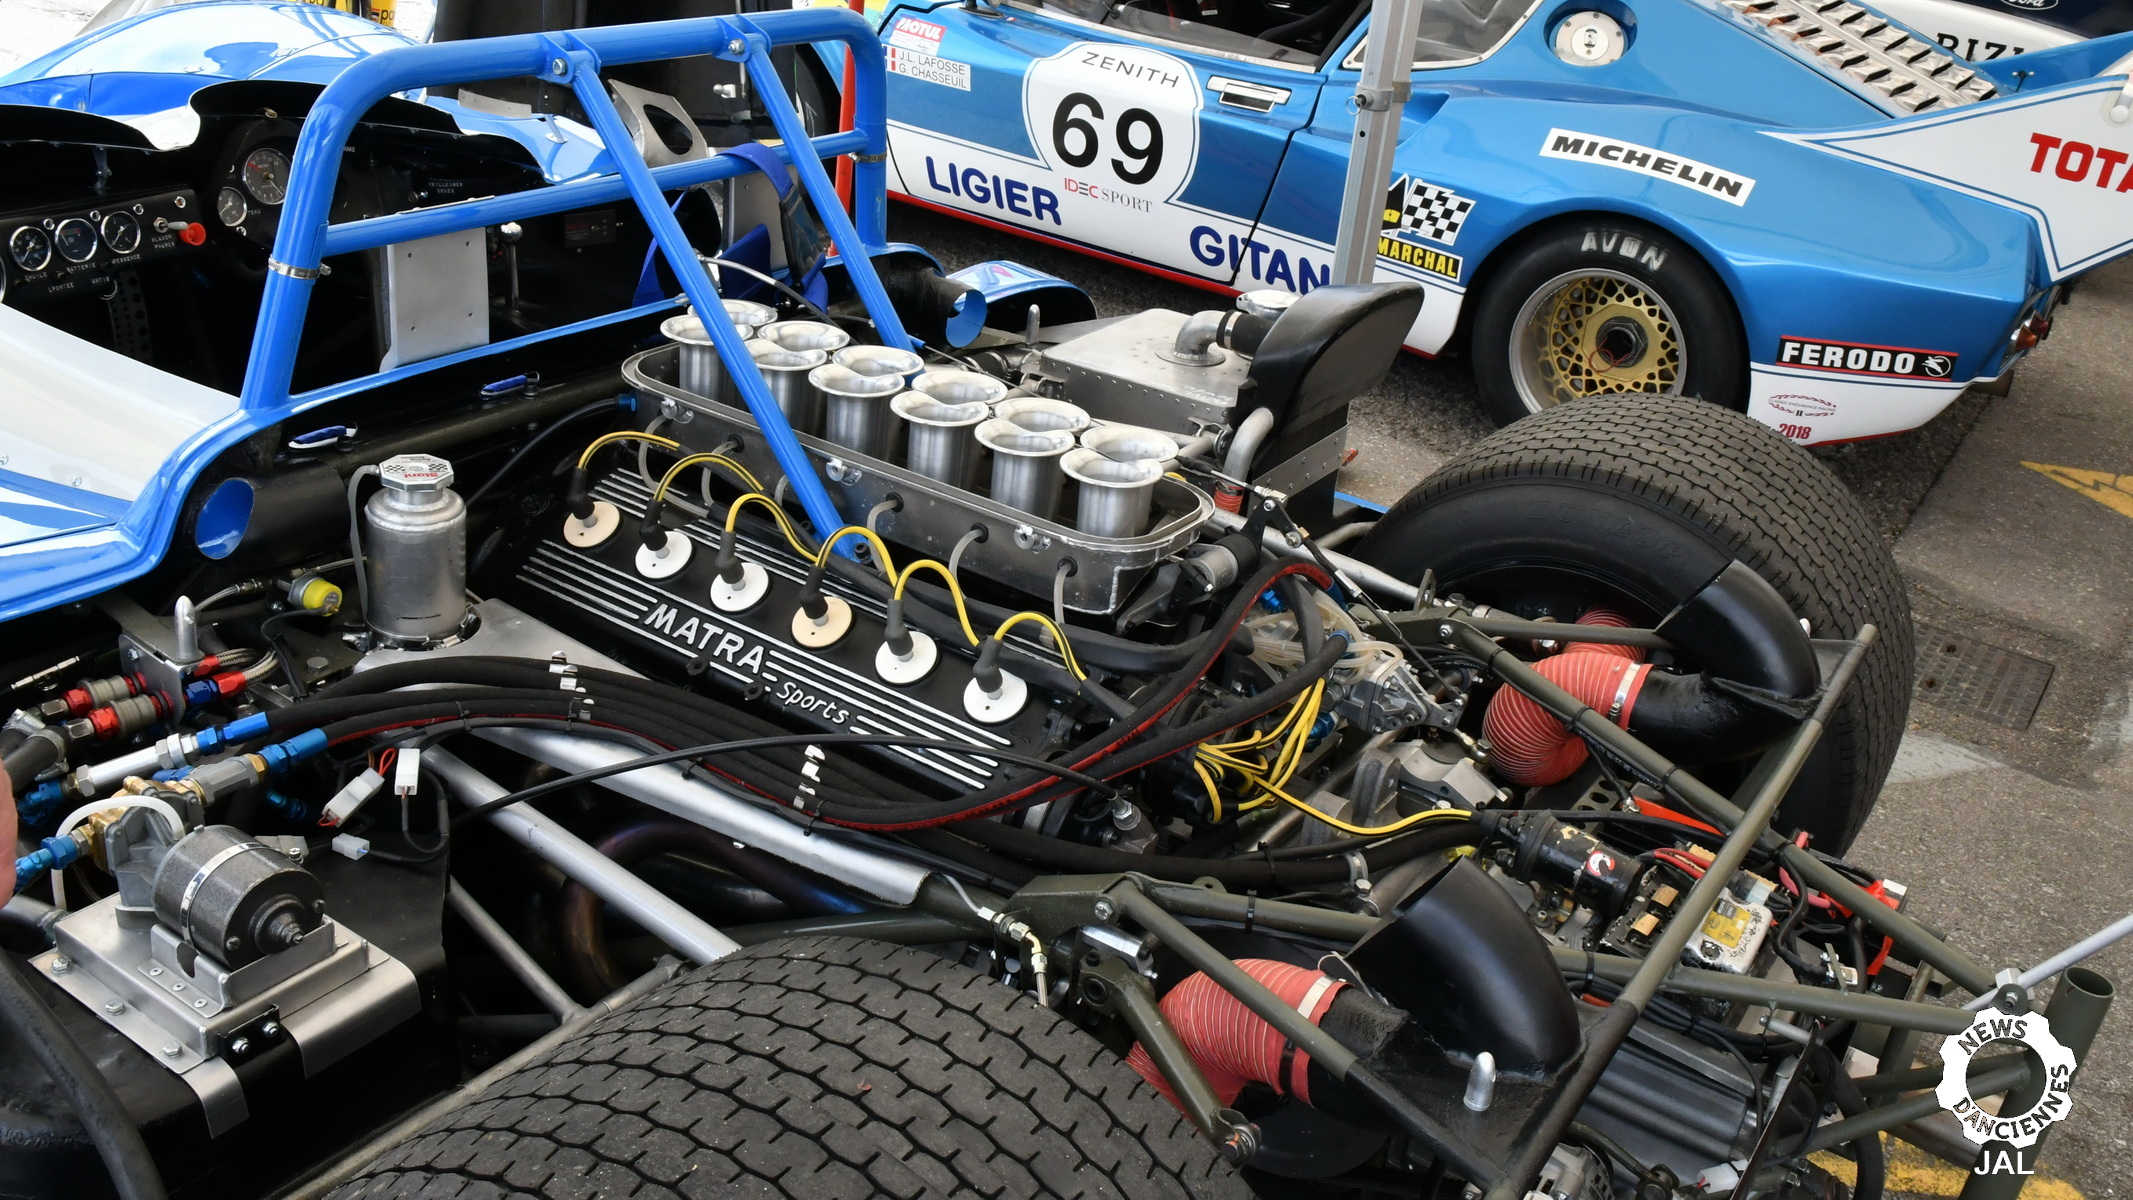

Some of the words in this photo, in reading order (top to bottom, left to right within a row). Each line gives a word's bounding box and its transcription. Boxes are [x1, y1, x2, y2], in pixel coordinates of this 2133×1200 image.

[894, 17, 942, 40] MOTUL
[899, 51, 916, 63] J.L.
[918, 55, 965, 75] LAFOSSE
[1937, 33, 2025, 62] RIZ
[898, 63, 909, 74] G.
[911, 66, 967, 89] CHASSEUIL
[1082, 51, 1180, 88] ZENITH
[1052, 92, 1164, 185] 69
[1551, 135, 1743, 198] MICHELIN
[925, 155, 1062, 226] LIGIER
[1064, 178, 1099, 200] IDEC
[1101, 187, 1153, 213] SPORT
[1190, 225, 1331, 296] GITAN
[1378, 236, 1457, 277] MARCHAL
[1580, 231, 1670, 272] AVON
[1782, 341, 1916, 375] FERODO
[1768, 398, 1788, 406] CLASSIC
[1788, 402, 1818, 410] ENDURANCE
[1778, 423, 1812, 440] 2018
[644, 603, 764, 674] MATRA
